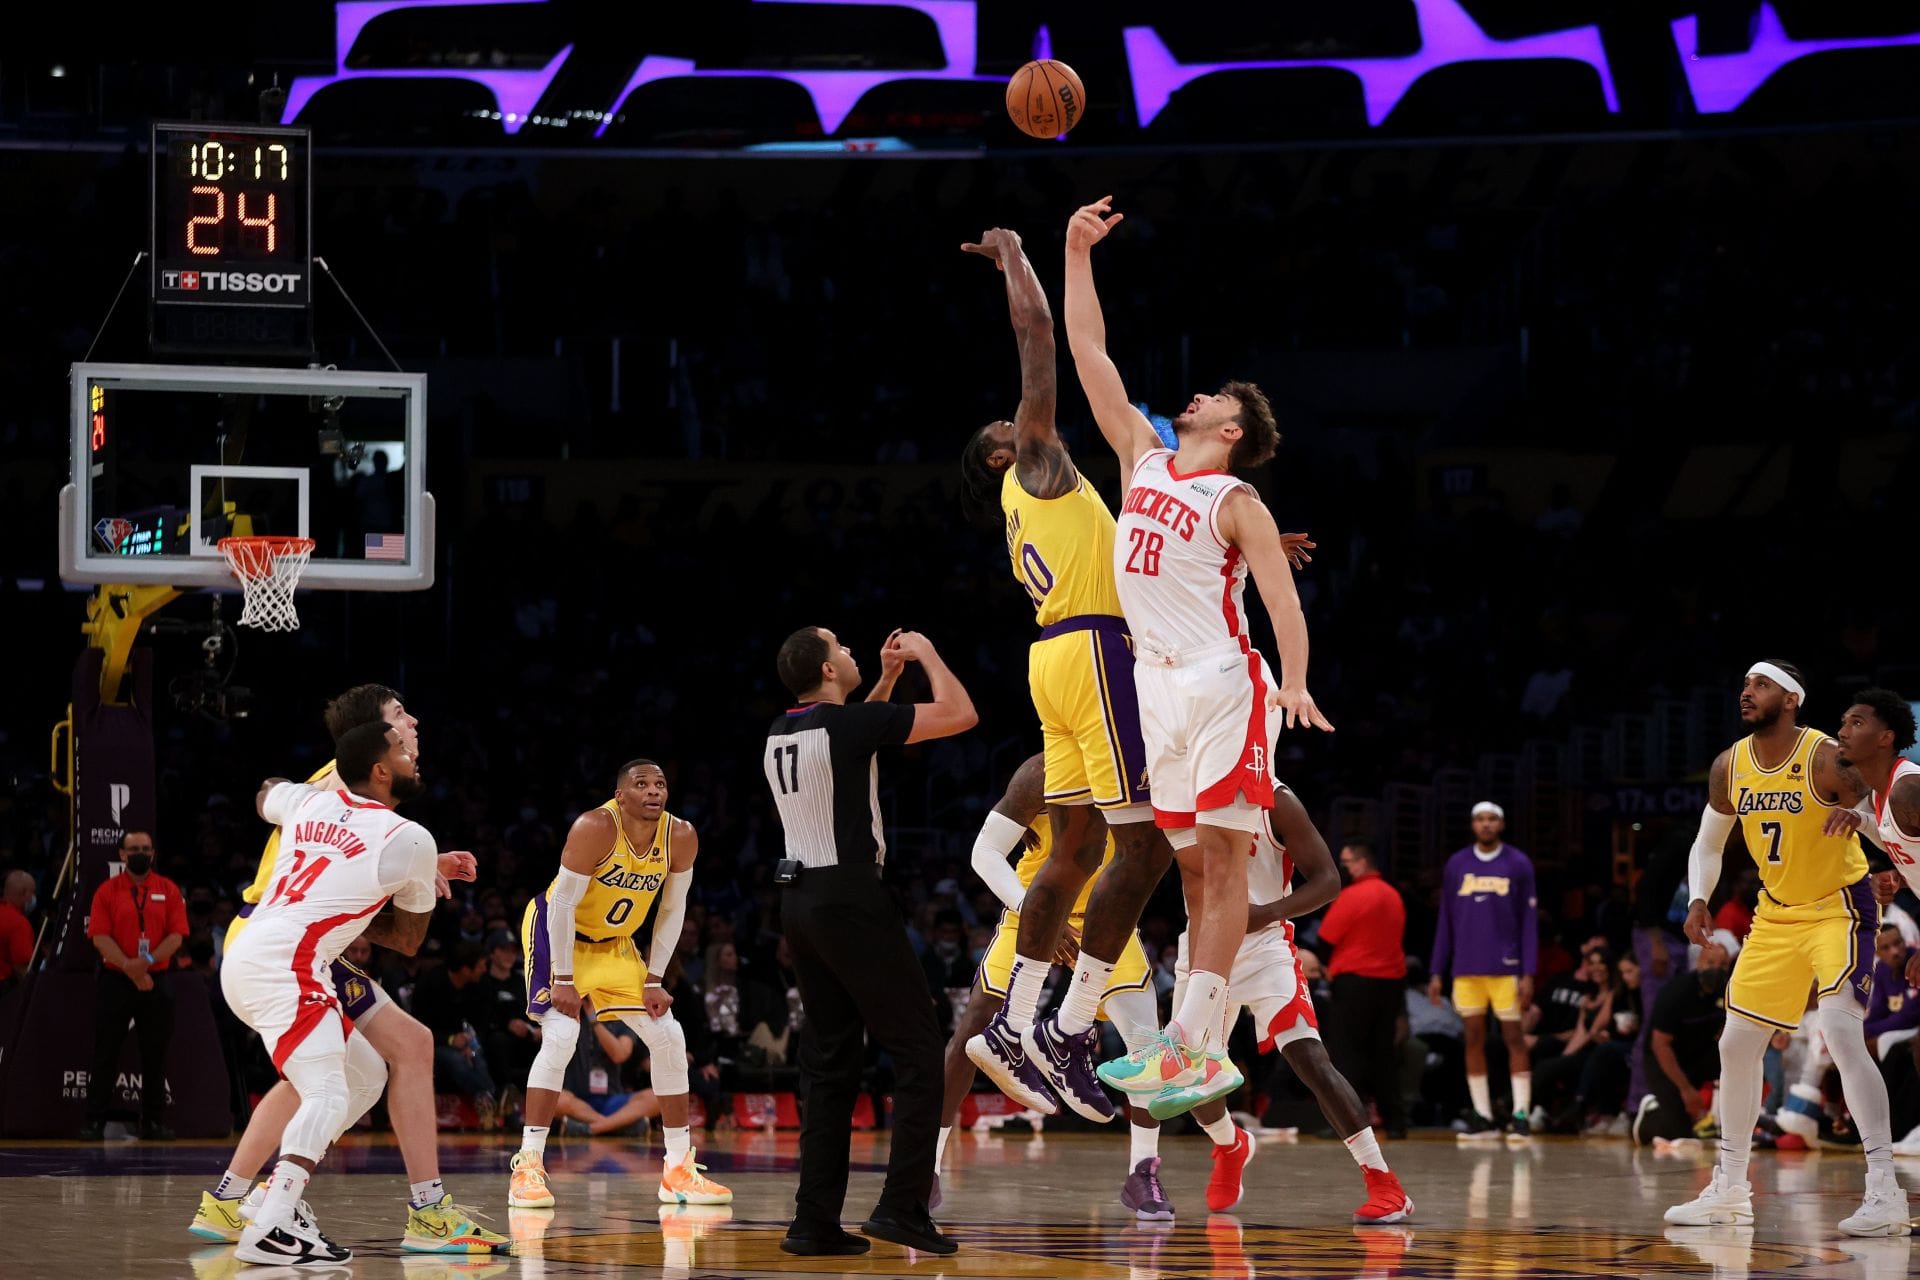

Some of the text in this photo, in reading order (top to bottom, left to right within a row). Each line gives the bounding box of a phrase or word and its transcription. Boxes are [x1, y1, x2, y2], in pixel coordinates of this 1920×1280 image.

[191, 142, 287, 180] 10:17
[187, 186, 275, 255] 24
[201, 272, 301, 293] TISSOT
[1190, 484, 1215, 498] MONEY
[1125, 528, 1164, 577] 28
[774, 744, 799, 794] 17
[1738, 787, 1804, 815] LAKERS
[91, 828, 125, 838] PECHA
[295, 821, 367, 859] AUGUSTIN
[1761, 822, 1781, 862] 7
[267, 849, 332, 906] 14
[596, 864, 662, 891] LAKERS
[606, 898, 634, 925] 0
